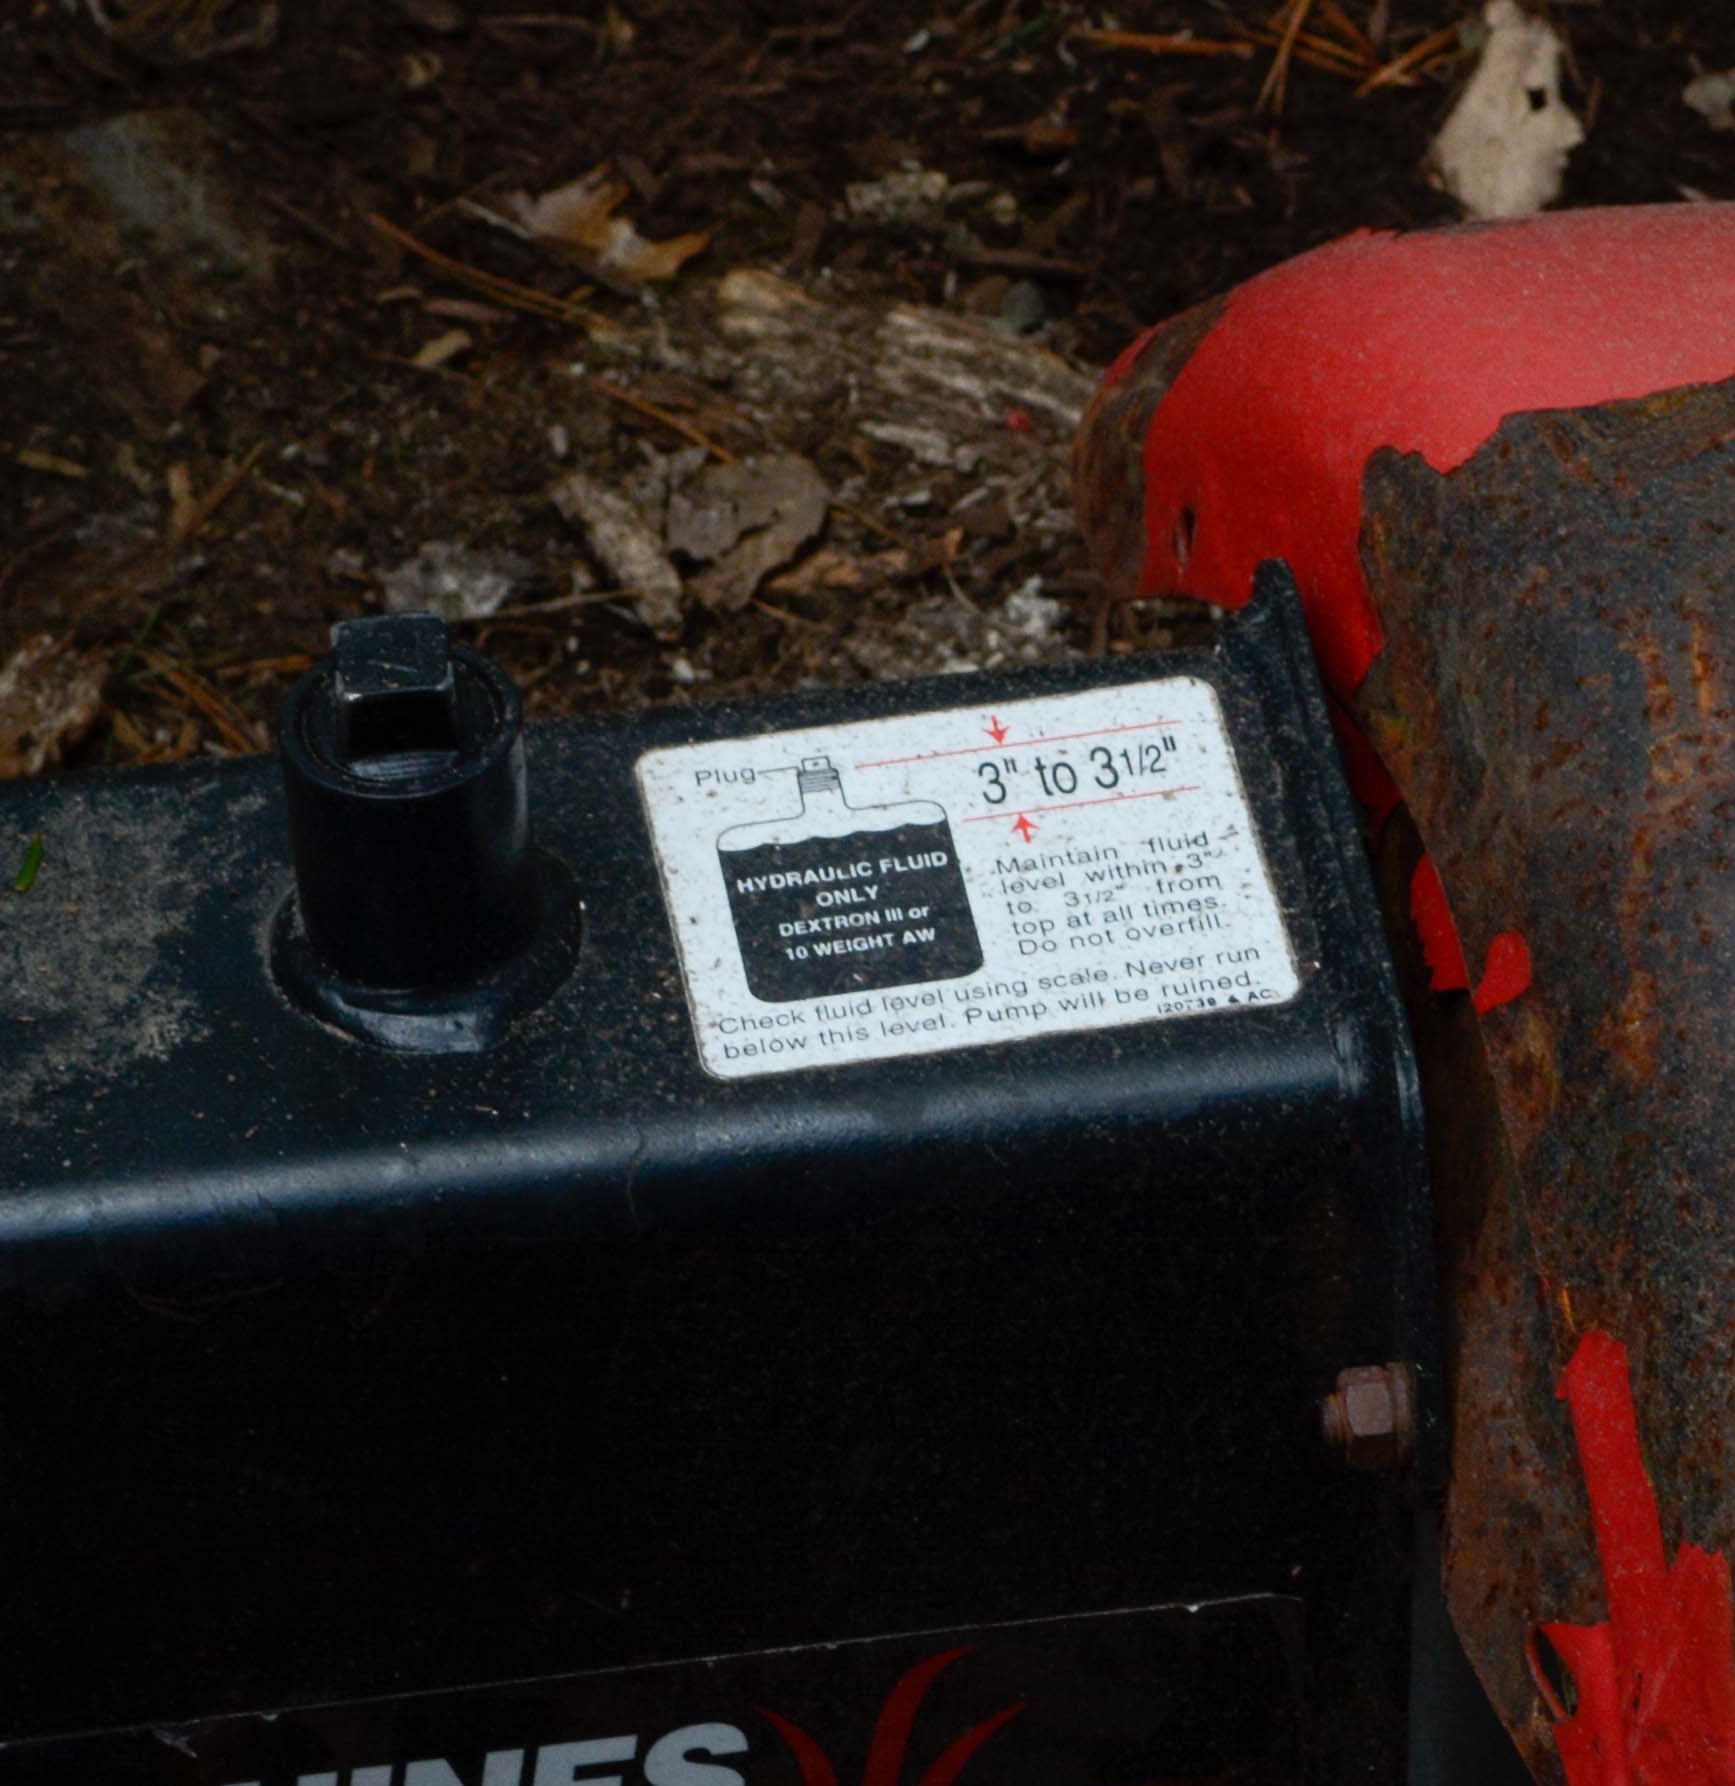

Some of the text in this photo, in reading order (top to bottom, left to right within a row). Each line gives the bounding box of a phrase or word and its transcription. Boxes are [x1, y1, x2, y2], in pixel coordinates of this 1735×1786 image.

[694, 767, 756, 787] Plug
[978, 757, 1018, 805] 3"
[1035, 755, 1078, 796] to
[736, 850, 948, 894] HYDRAULIC FLUID
[995, 831, 1209, 875] Maintain fluid
[815, 884, 880, 908] ONLY
[1000, 872, 1065, 894] level
[1084, 856, 1167, 883] within
[1006, 900, 1033, 916] to
[1156, 874, 1224, 896] from
[778, 906, 930, 937] DEXTRON III or
[1013, 895, 1227, 936] top at all times.
[1017, 913, 1231, 956] Do not overfill.
[786, 928, 937, 961] 10 WEIGHT AW
[719, 1008, 806, 1035] Check
[814, 999, 872, 1022] fluid
[880, 988, 944, 1012] level
[954, 978, 1028, 1001] using
[1125, 953, 1205, 978] Never
[1216, 946, 1260, 965] run
[724, 970, 1261, 1060] below this level. Pump will be ruined.
